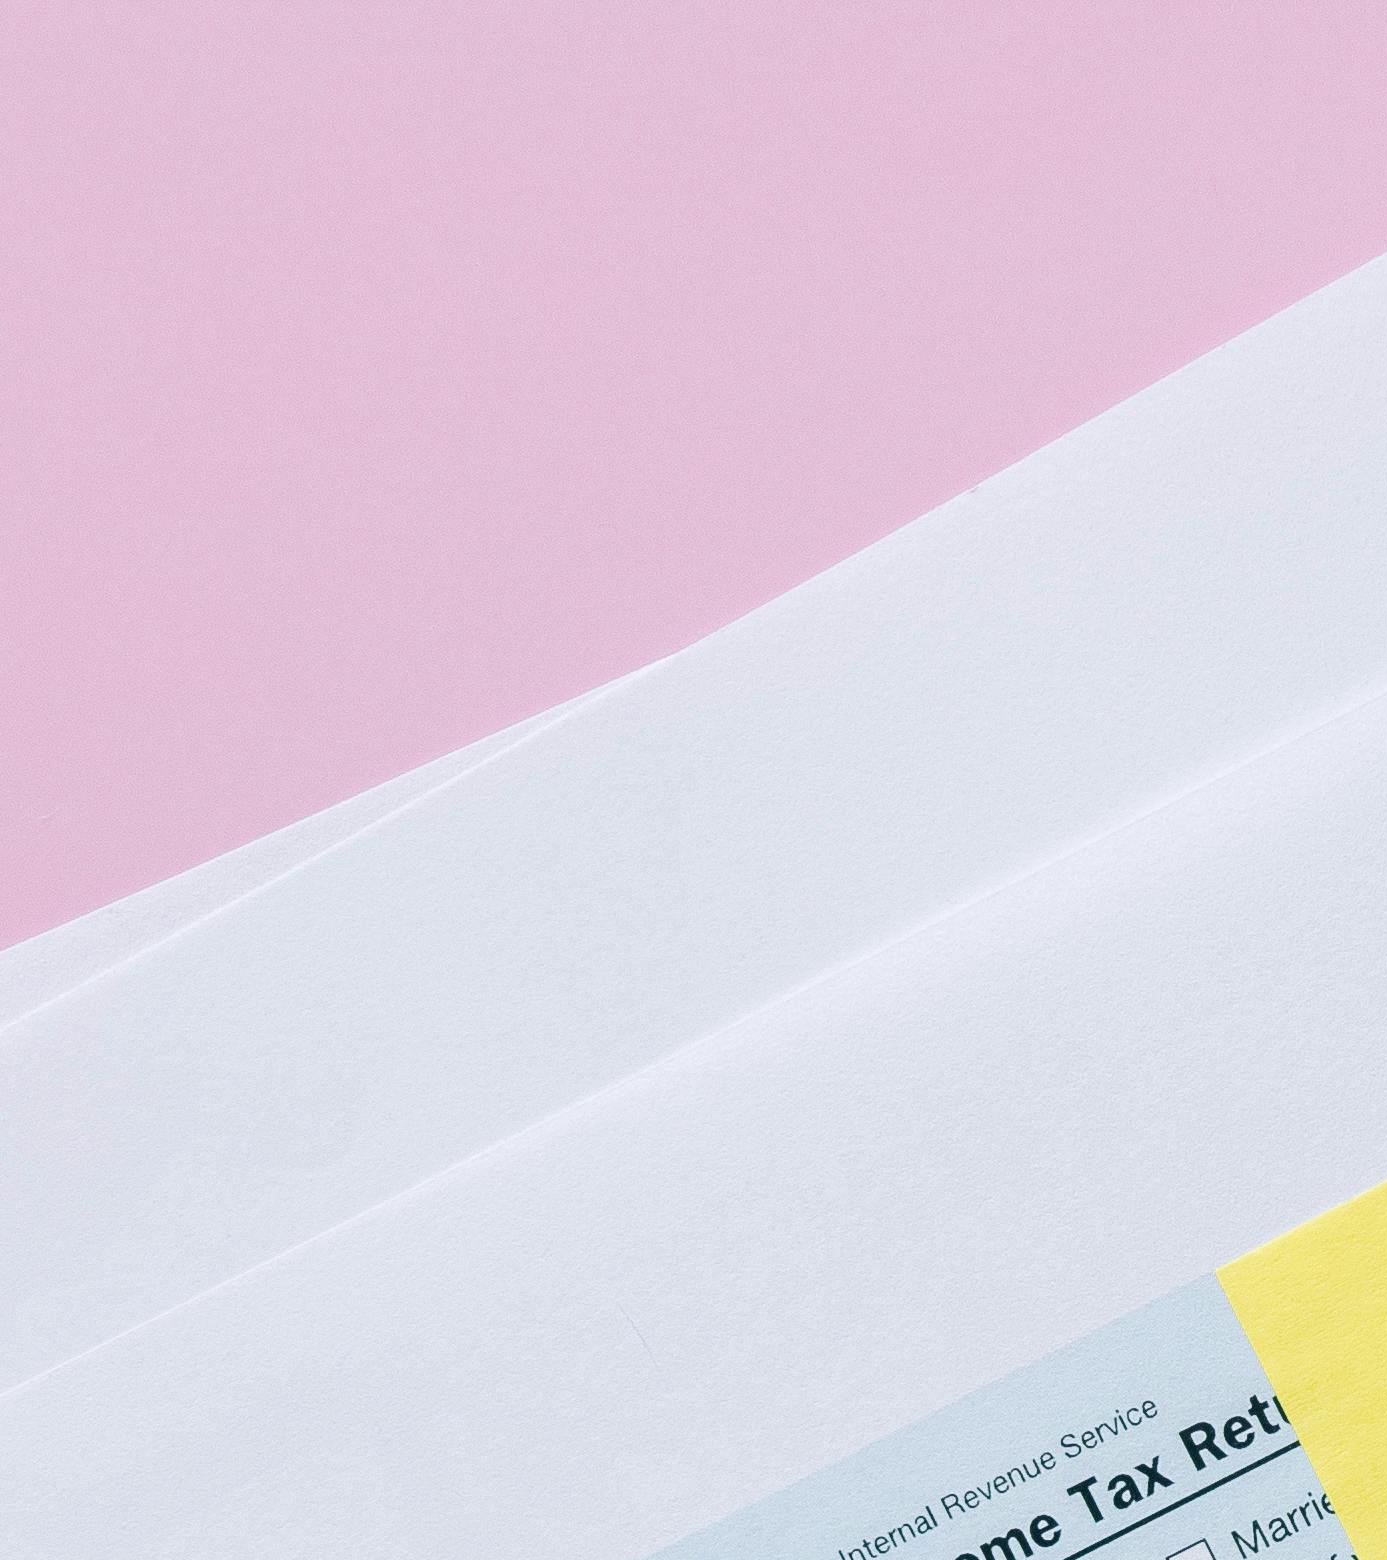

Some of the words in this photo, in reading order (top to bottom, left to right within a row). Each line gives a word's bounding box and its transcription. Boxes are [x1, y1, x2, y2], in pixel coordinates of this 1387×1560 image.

[939, 1450, 1058, 1521] Revenue
[1058, 1398, 1159, 1460] Service
[1065, 1454, 1176, 1525] Tax
